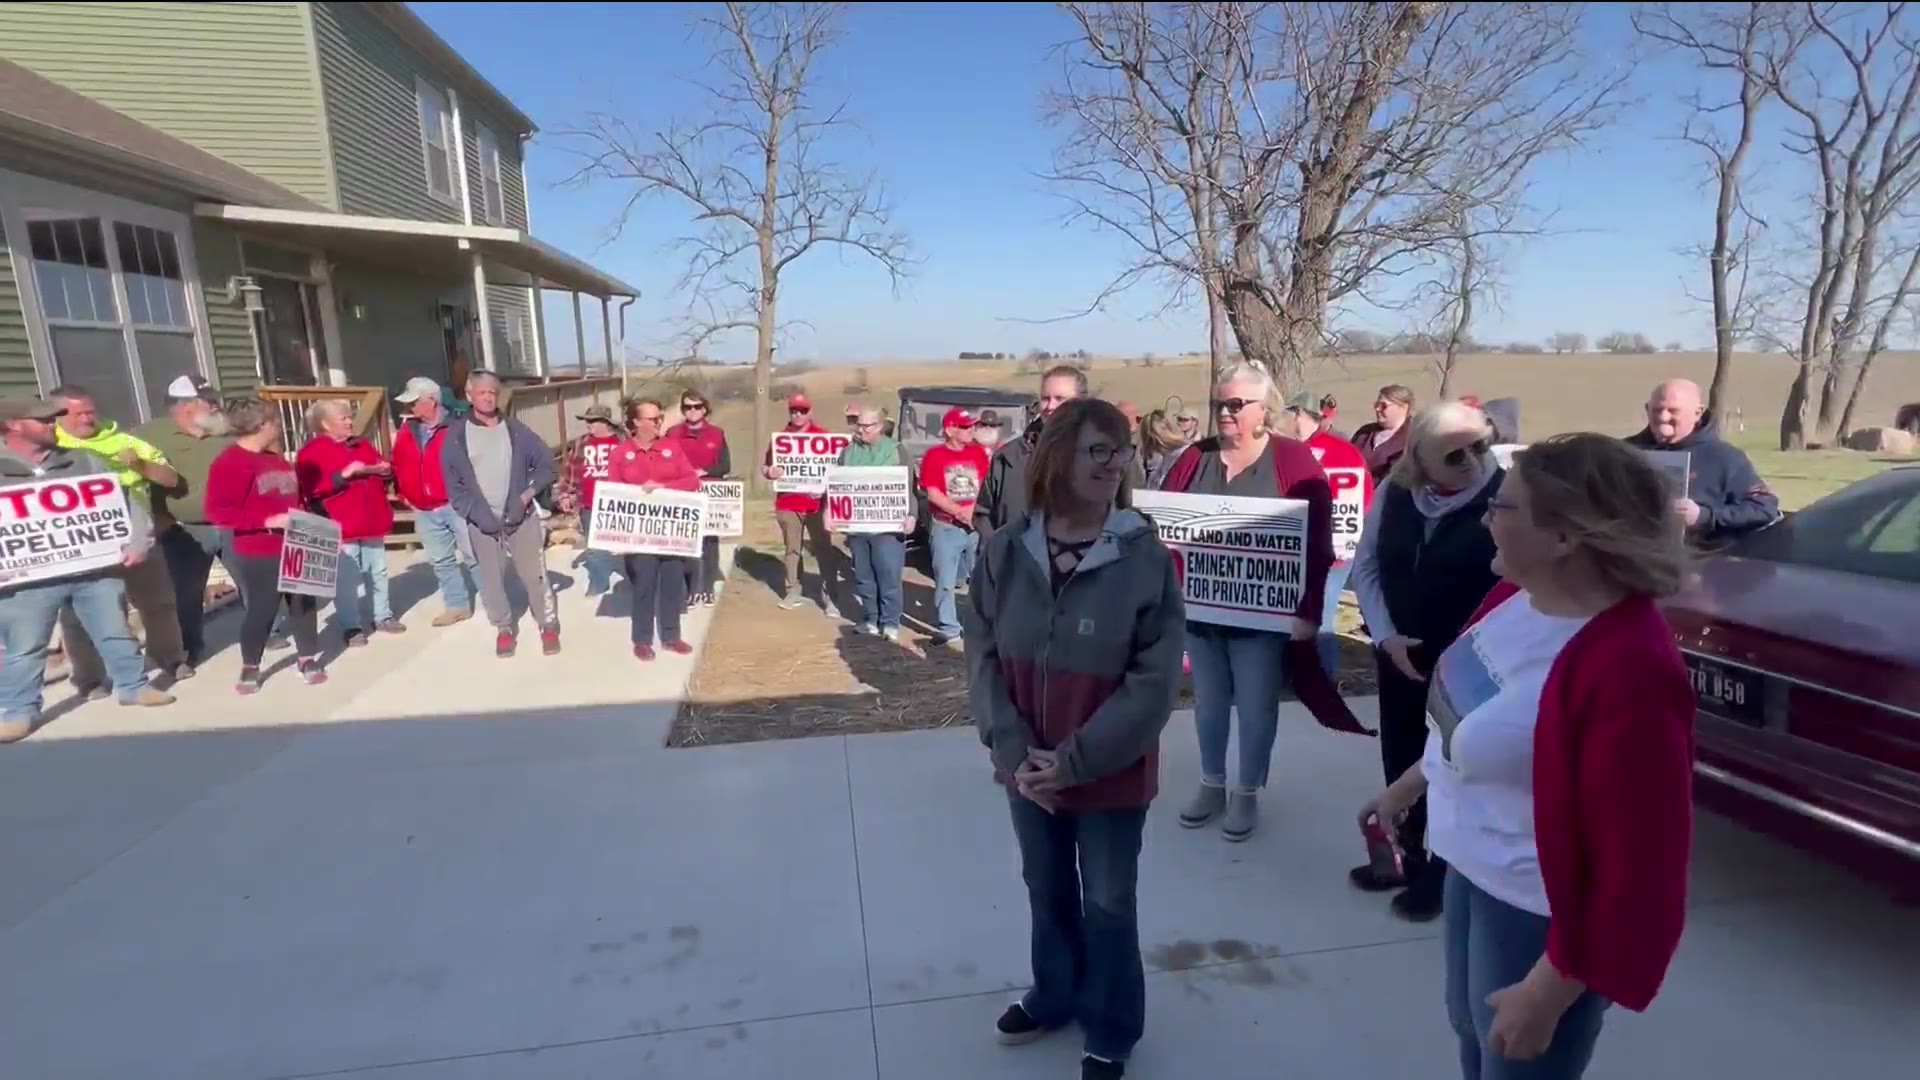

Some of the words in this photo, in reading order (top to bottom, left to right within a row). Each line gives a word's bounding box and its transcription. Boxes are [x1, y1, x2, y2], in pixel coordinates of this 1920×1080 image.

[584, 444, 617, 466] RE
[775, 436, 849, 455] STOP
[776, 456, 812, 464] DEADLY
[0, 478, 115, 519] TOP
[598, 498, 700, 521] LANDOWNERS
[829, 496, 852, 520] NO
[853, 496, 880, 507] EMINENT
[881, 496, 907, 508] DOMAIN
[0, 518, 47, 537] ADLY
[52, 508, 124, 529] CARBON
[596, 512, 635, 534] STAND
[639, 516, 699, 539] TOGETHER
[0, 521, 129, 558] IPELINES
[1160, 524, 1189, 542] TECT
[1191, 529, 1223, 545] LAND
[1225, 532, 1252, 548] AND
[1256, 534, 1302, 551] WATER
[7, 553, 56, 570] EASEMENT
[58, 548, 83, 561] TEAM
[283, 545, 304, 580] NO
[1188, 552, 1243, 579] EMINENT
[1246, 557, 1301, 586] DOMAIN
[1187, 577, 1210, 599] FOR
[1213, 580, 1264, 606] PRIVATE
[1268, 586, 1299, 610] GAIN
